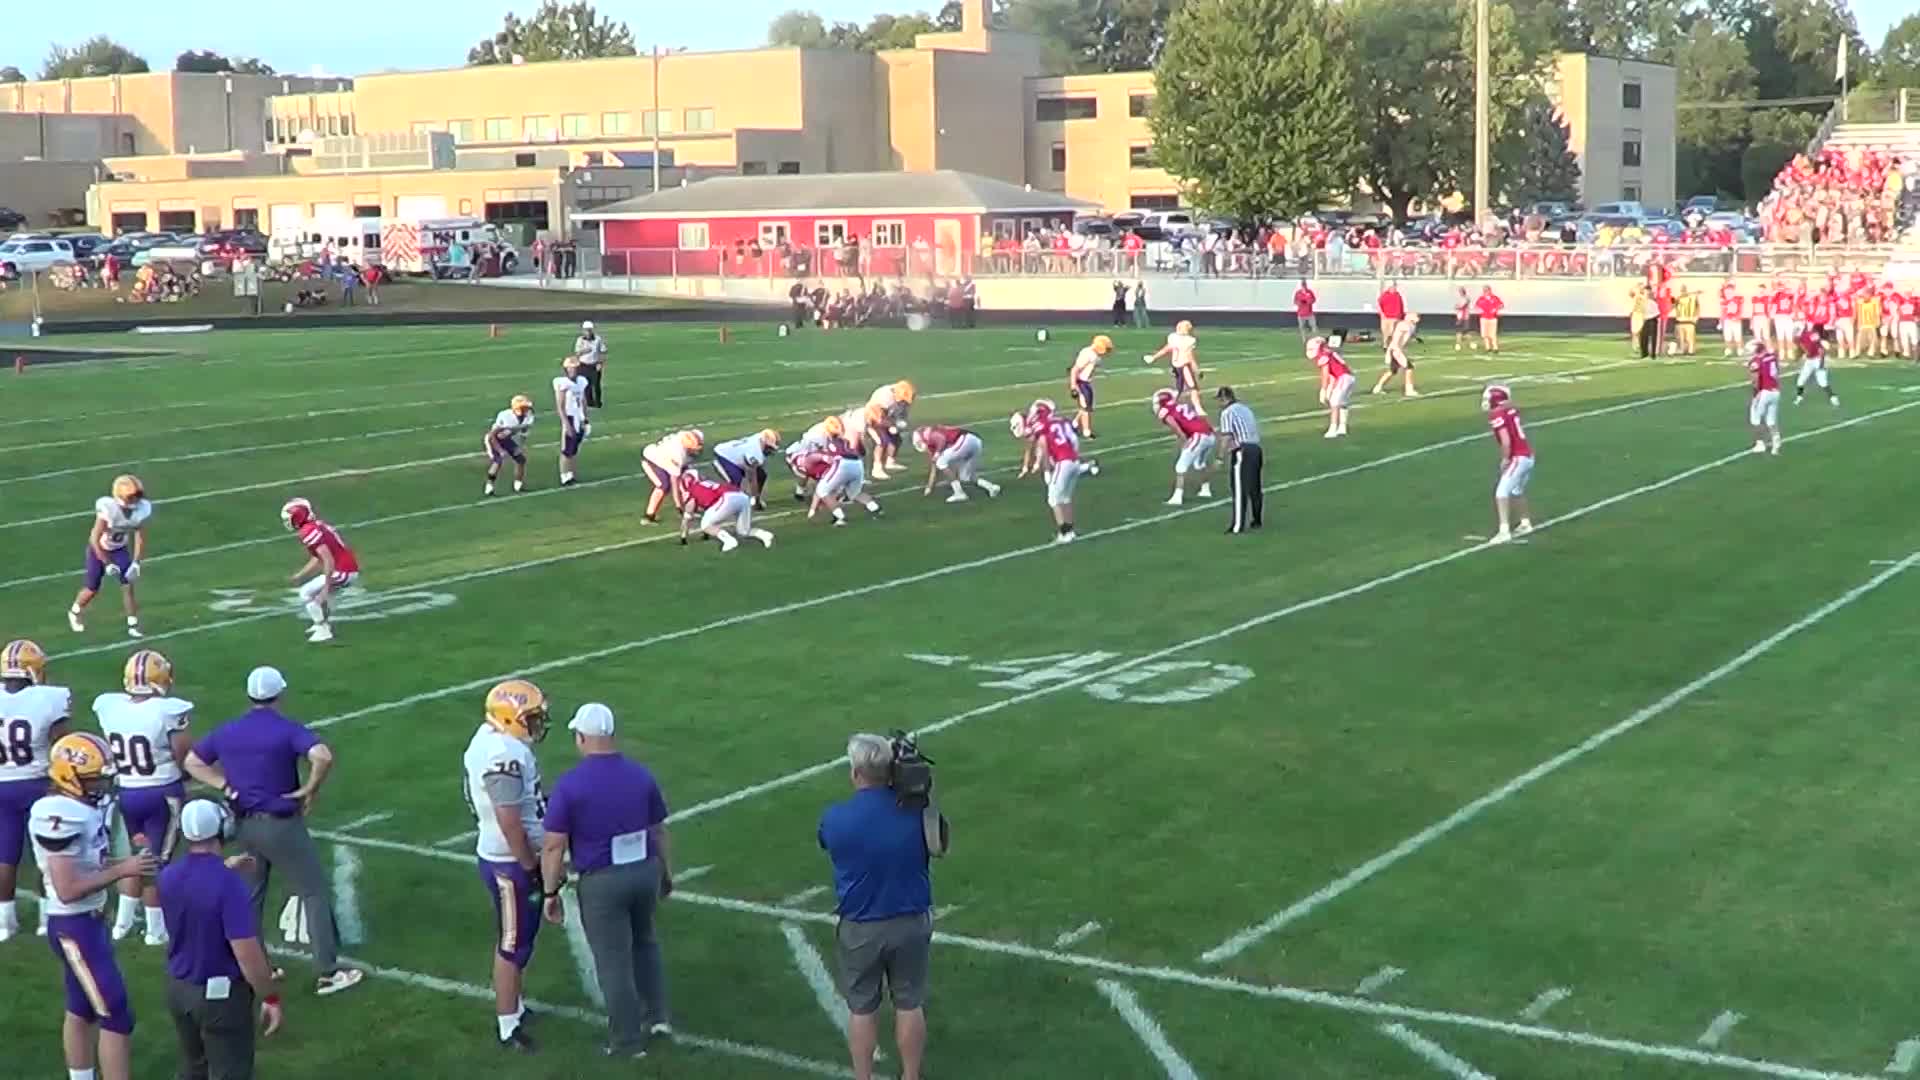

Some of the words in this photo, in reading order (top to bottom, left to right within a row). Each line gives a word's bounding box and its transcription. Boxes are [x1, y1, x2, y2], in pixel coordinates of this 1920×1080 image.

[969, 650, 1256, 703] 40
[0, 717, 33, 767] 8
[109, 732, 156, 776] 20
[49, 815, 62, 831] 7
